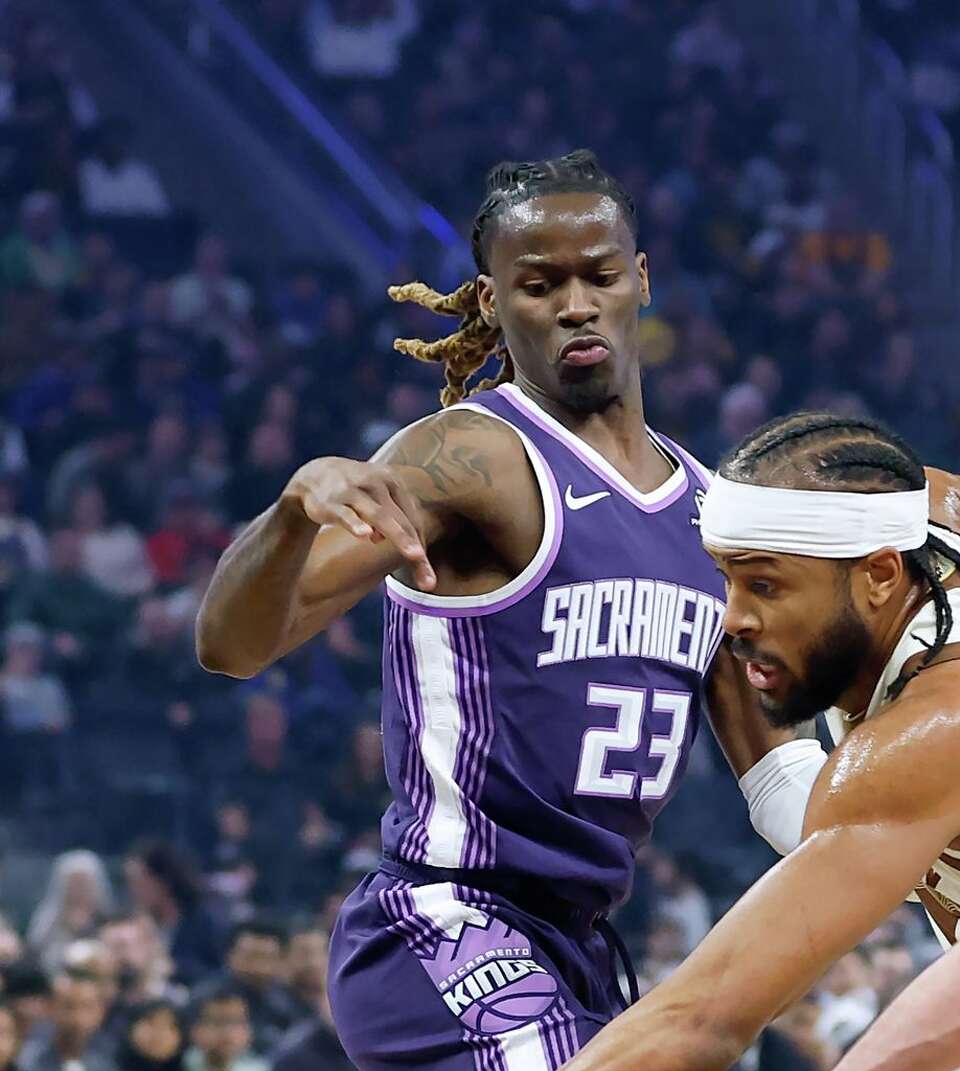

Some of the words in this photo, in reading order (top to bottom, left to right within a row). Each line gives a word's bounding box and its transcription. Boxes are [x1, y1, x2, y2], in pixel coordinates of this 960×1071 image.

[574, 682, 693, 800] 23
[439, 947, 530, 990] SACRAMENTO
[442, 958, 548, 1017] KINGS
